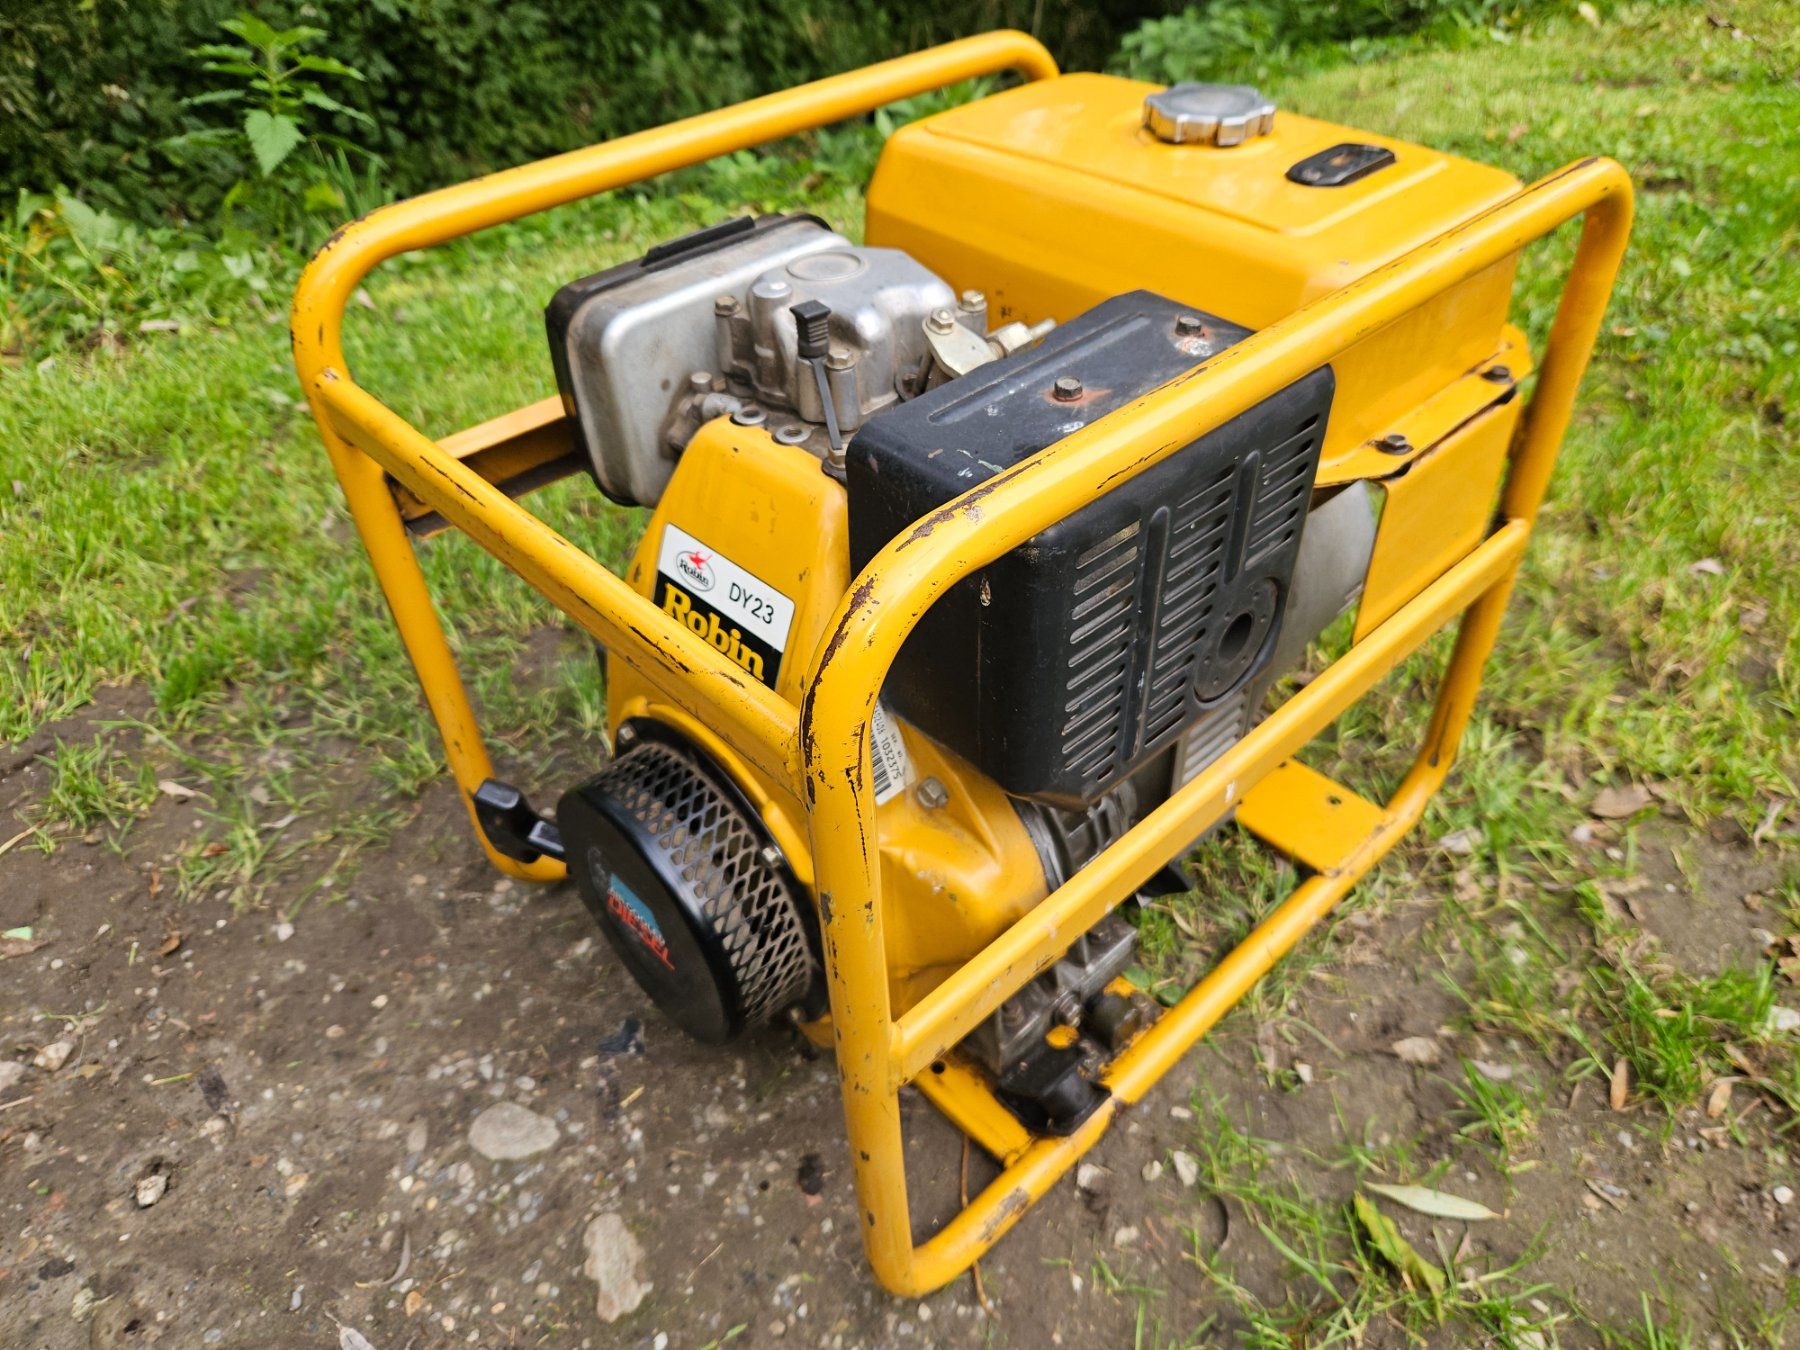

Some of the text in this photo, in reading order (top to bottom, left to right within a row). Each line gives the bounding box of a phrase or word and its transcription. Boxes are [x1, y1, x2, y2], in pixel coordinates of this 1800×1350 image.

[680, 558, 709, 586] Robin
[729, 582, 775, 625] DY23
[663, 583, 765, 681] Robin
